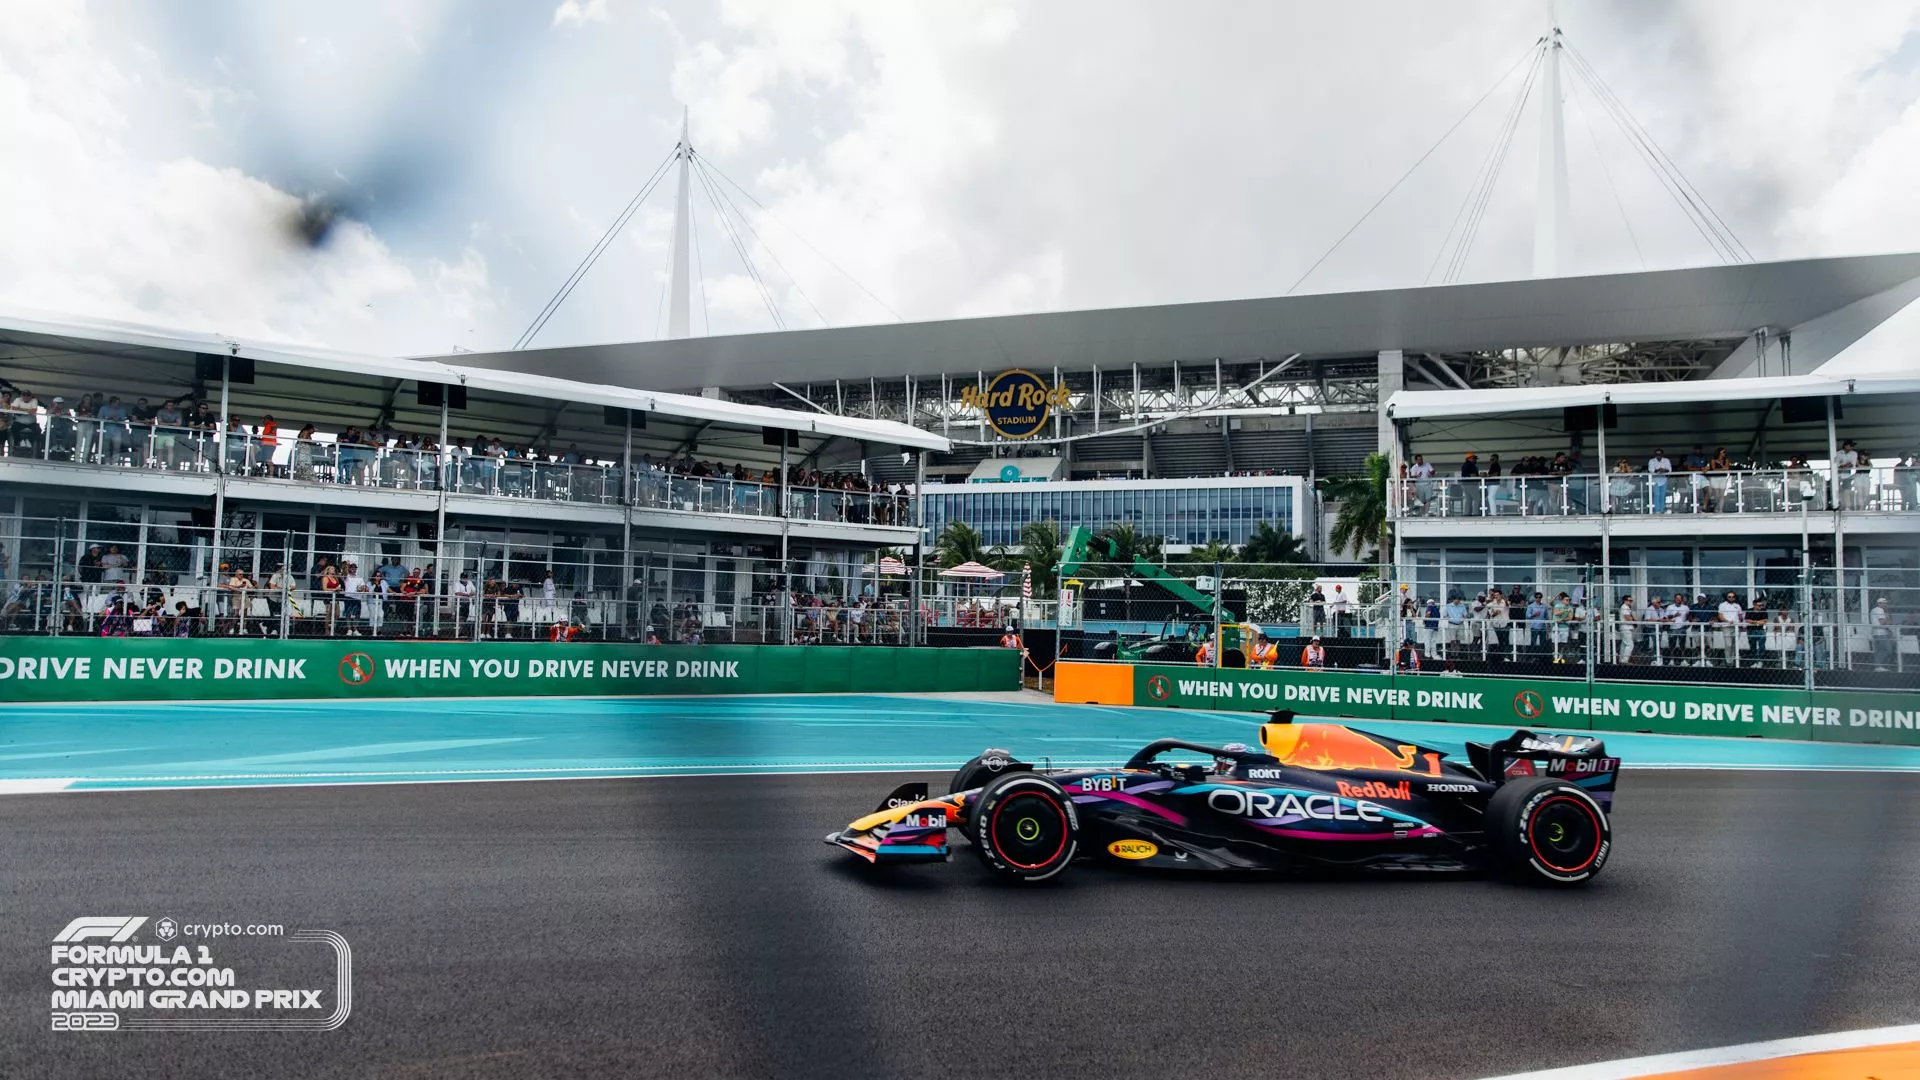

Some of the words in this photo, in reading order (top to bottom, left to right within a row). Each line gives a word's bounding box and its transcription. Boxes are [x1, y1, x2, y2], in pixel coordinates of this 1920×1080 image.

[961, 384, 1015, 409] Hard
[1018, 381, 1071, 411] Rock
[997, 416, 1037, 425] STADIUM
[0, 657, 91, 679] DRIVE
[103, 658, 203, 679] NEVER
[214, 658, 307, 679] DRINK
[384, 659, 461, 678] WHEN
[469, 659, 520, 678] YOU
[528, 659, 594, 678] DRIVE
[601, 660, 669, 678] NEVER
[676, 661, 739, 678] DRINK
[1178, 680, 1234, 697] WHEN
[1240, 682, 1278, 700] YOU
[1284, 684, 1340, 703] DRIVE
[1346, 687, 1410, 706] NEVER
[1416, 691, 1484, 710] DRINK
[1552, 696, 1620, 716] WHEN
[1627, 699, 1676, 719] YOU
[1684, 702, 1754, 722] DRIVE
[1762, 705, 1841, 726] NEVER
[1849, 708, 1920, 729] DRIN
[1248, 768, 1281, 778] ROKT
[1550, 759, 1598, 772] Mobil
[1081, 775, 1127, 792] BYBIT
[1427, 783, 1479, 793] HONDA
[1208, 788, 1384, 822] ORACLE
[905, 814, 947, 828] Mobil
[1121, 844, 1151, 853] RAUCH
